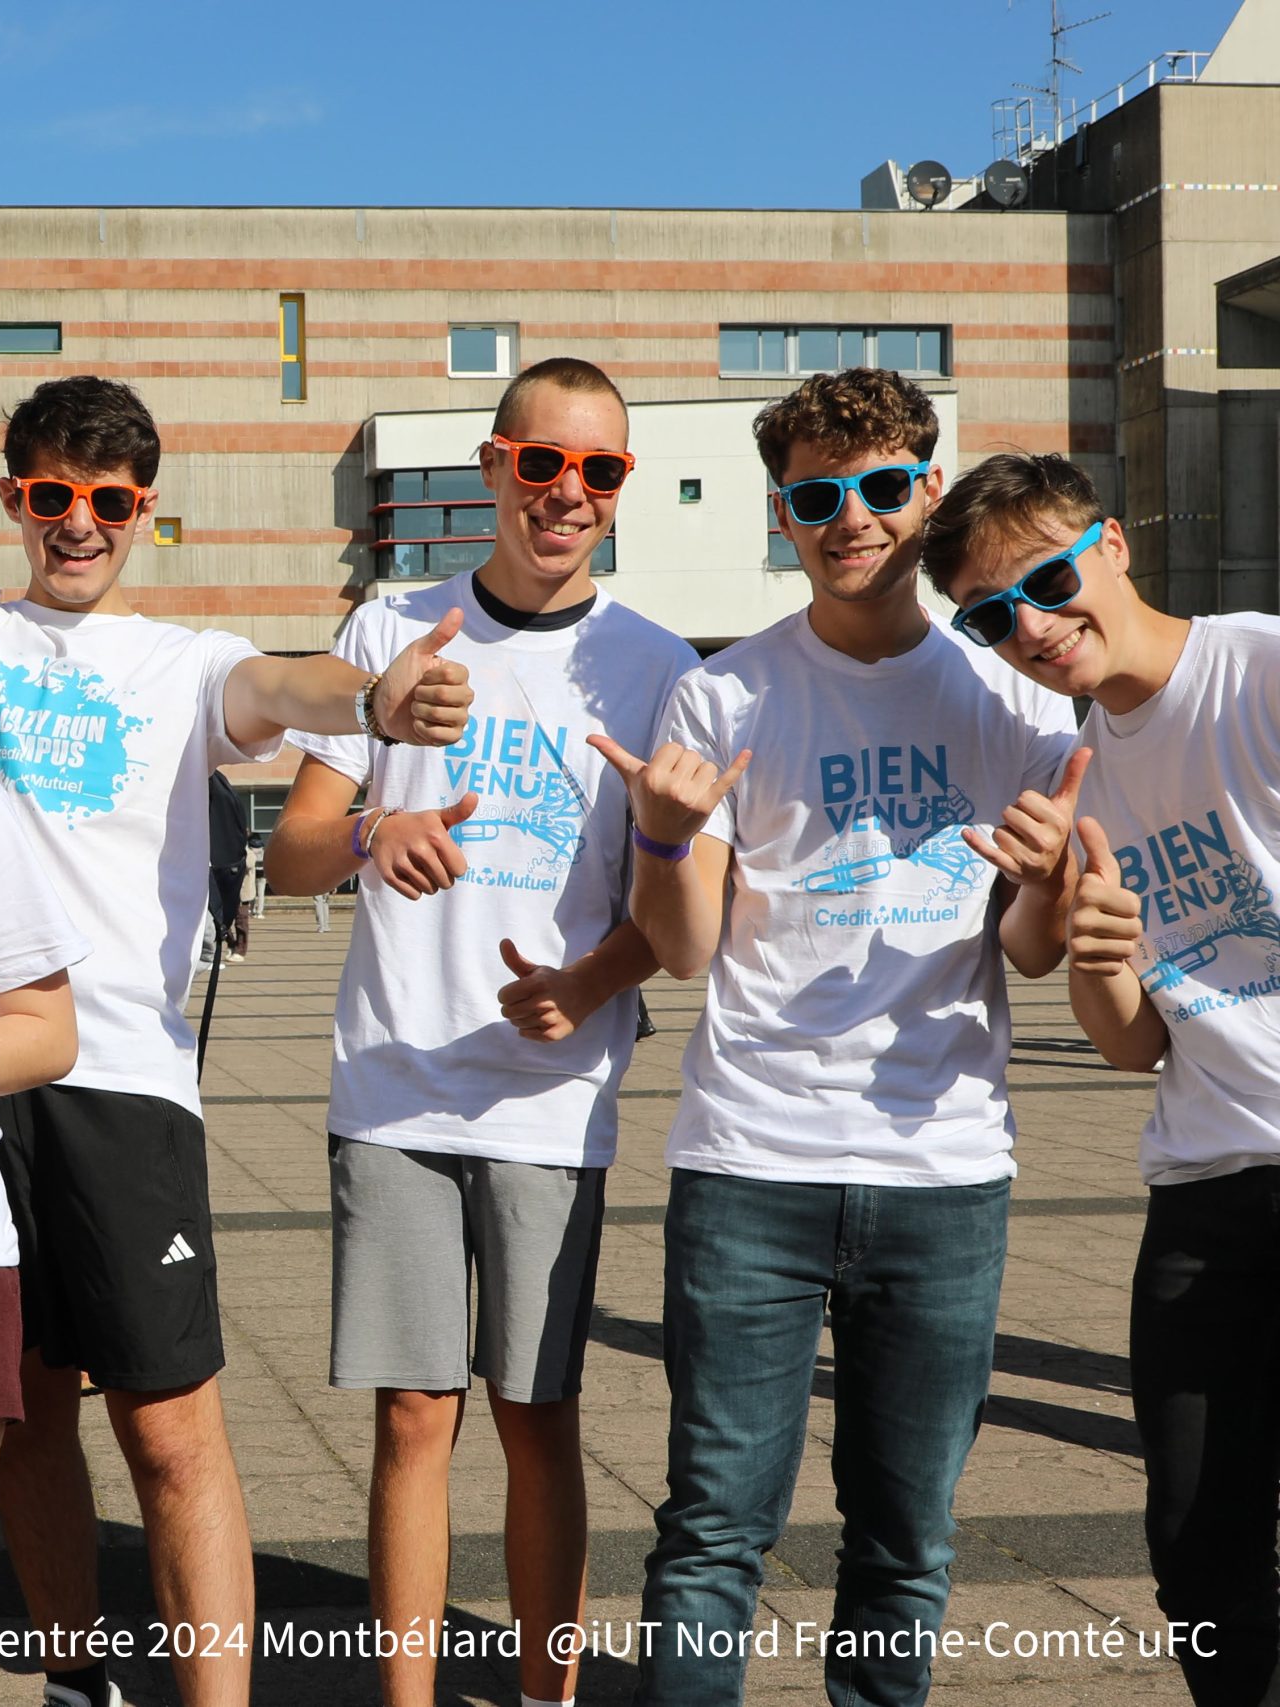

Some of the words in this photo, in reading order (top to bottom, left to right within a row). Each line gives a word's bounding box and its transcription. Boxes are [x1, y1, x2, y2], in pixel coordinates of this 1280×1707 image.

[52, 714, 107, 744] RUN
[445, 714, 567, 769] BIEN
[31, 774, 83, 794] Mutuel
[444, 758, 563, 802] VENUE
[820, 744, 948, 804] BIEN
[475, 804, 556, 827] UDIANTS
[825, 796, 949, 839] VENUE
[1114, 810, 1233, 895] BIEN
[497, 871, 557, 891] Mutuel
[815, 907, 873, 927] Crédit
[892, 905, 959, 924] Mutuel
